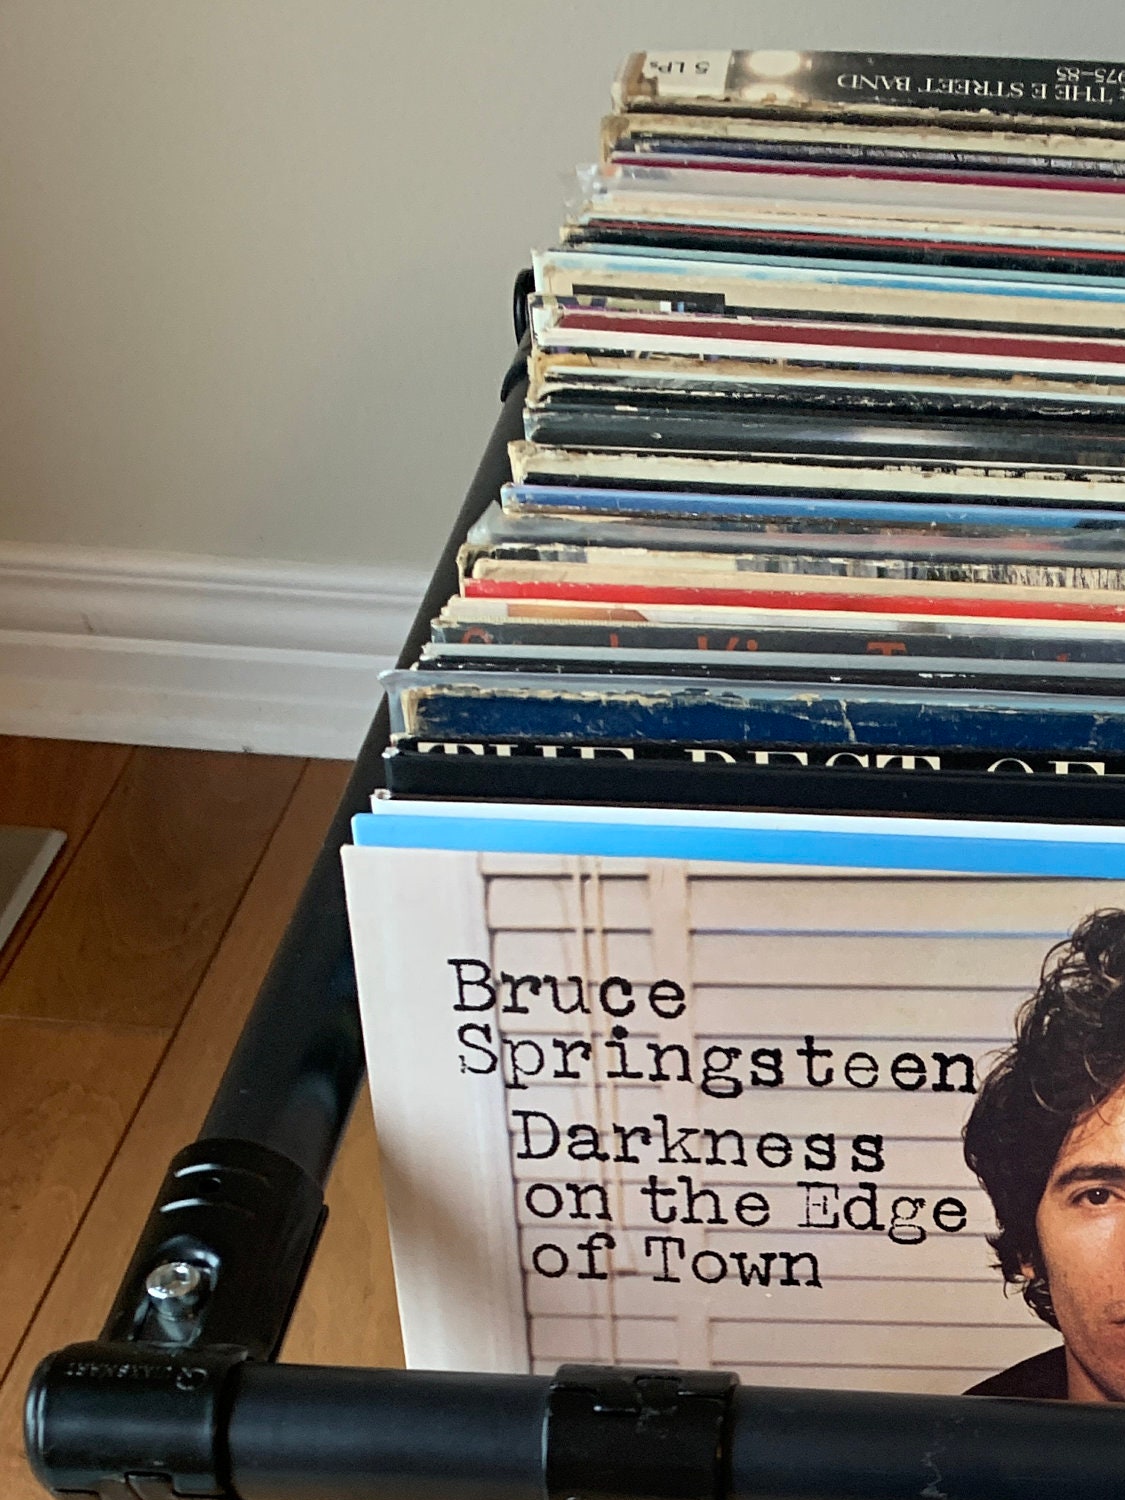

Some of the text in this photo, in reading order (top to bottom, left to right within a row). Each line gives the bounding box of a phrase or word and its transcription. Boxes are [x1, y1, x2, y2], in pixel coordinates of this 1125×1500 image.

[695, 60, 710, 75] 5
[837, 73, 911, 93] BAND
[918, 77, 1024, 99] STREET
[1031, 83, 1048, 100] E
[1054, 84, 1114, 106] THE
[447, 958, 687, 1019] Bruce
[457, 1022, 979, 1100] Springsteen
[511, 1109, 886, 1173] Darkness
[525, 1175, 969, 1245] on the Edge
[531, 1231, 823, 1289] of Town
